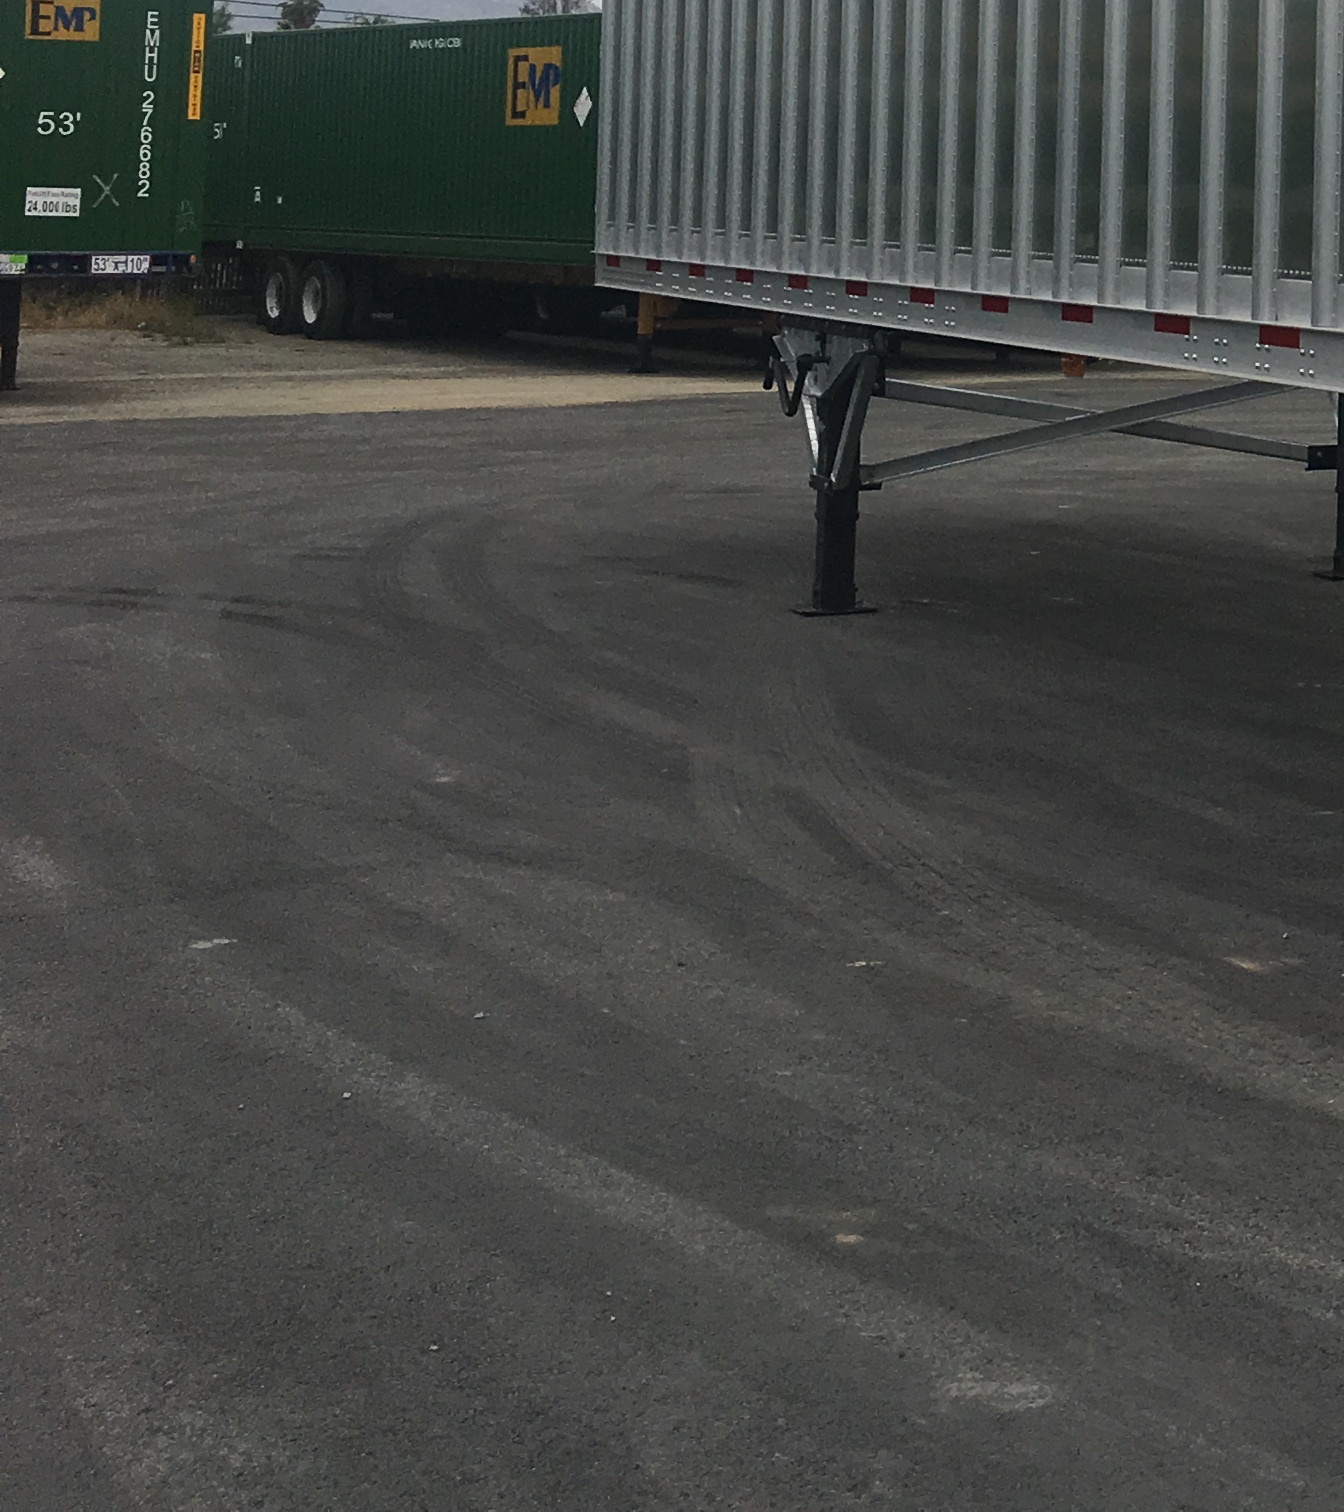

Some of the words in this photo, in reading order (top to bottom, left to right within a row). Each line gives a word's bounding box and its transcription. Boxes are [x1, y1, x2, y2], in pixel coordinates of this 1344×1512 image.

[29, 0, 96, 36] EMP
[144, 11, 160, 82] EMHU
[511, 54, 560, 120] EMP
[37, 111, 82, 136] 53'
[137, 90, 154, 198] 276682
[61, 200, 78, 214] lbs
